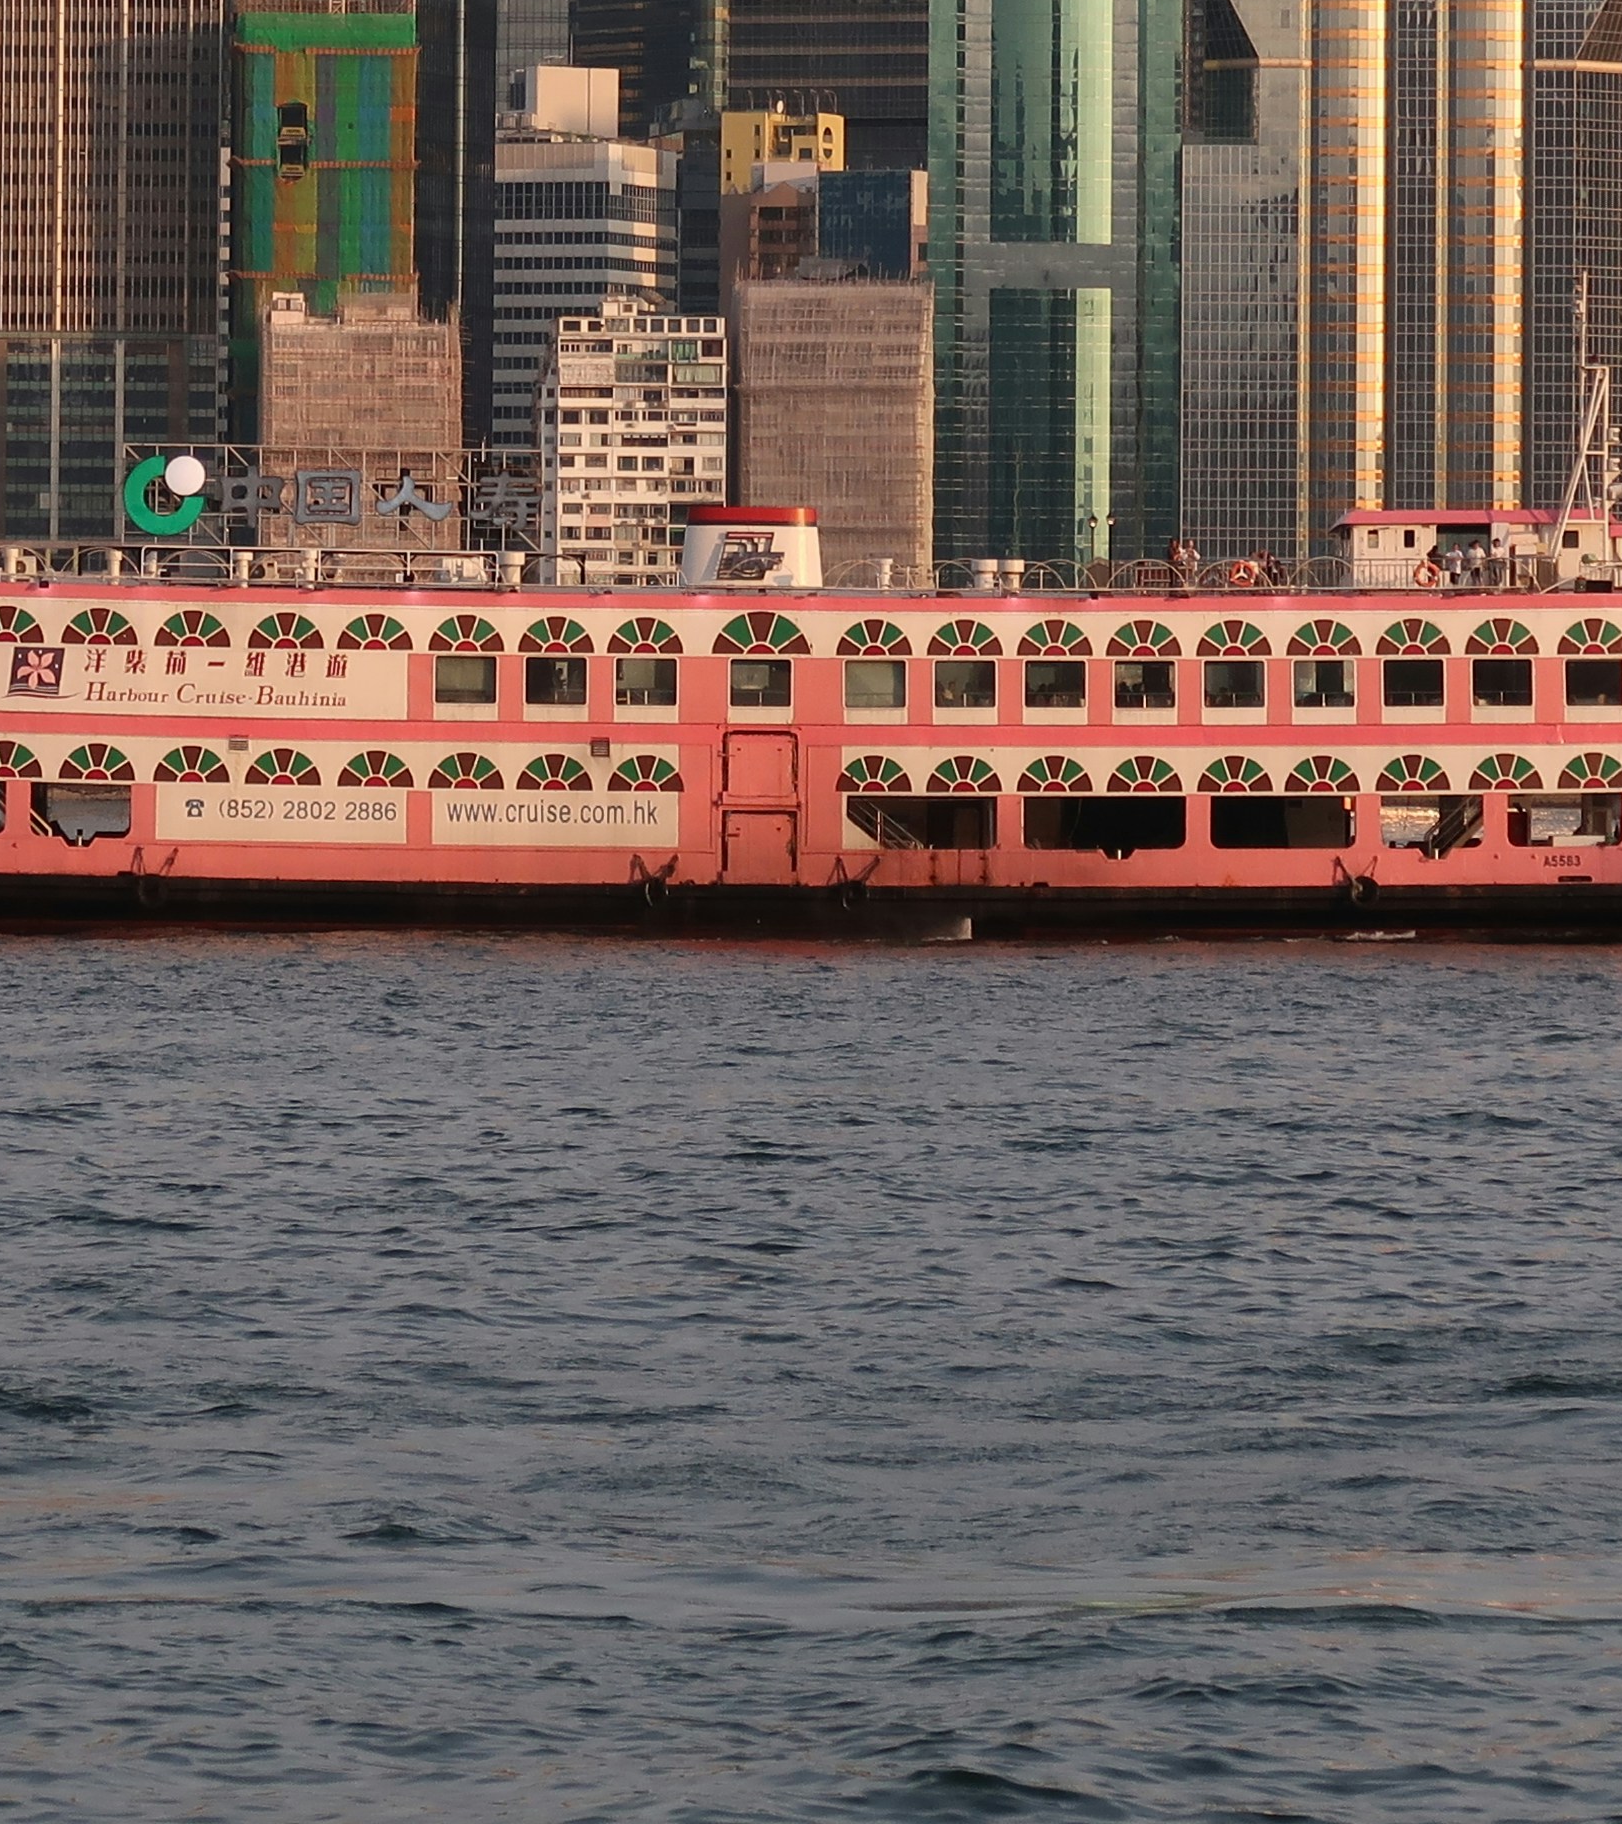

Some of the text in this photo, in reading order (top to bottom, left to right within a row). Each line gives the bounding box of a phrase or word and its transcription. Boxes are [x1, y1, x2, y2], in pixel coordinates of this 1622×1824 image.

[221, 464, 542, 529] 中国人寿
[83, 681, 169, 703] Harbour
[219, 799, 397, 821] (852) 2802 2886
[447, 800, 658, 825] www.cruise.com.hk
